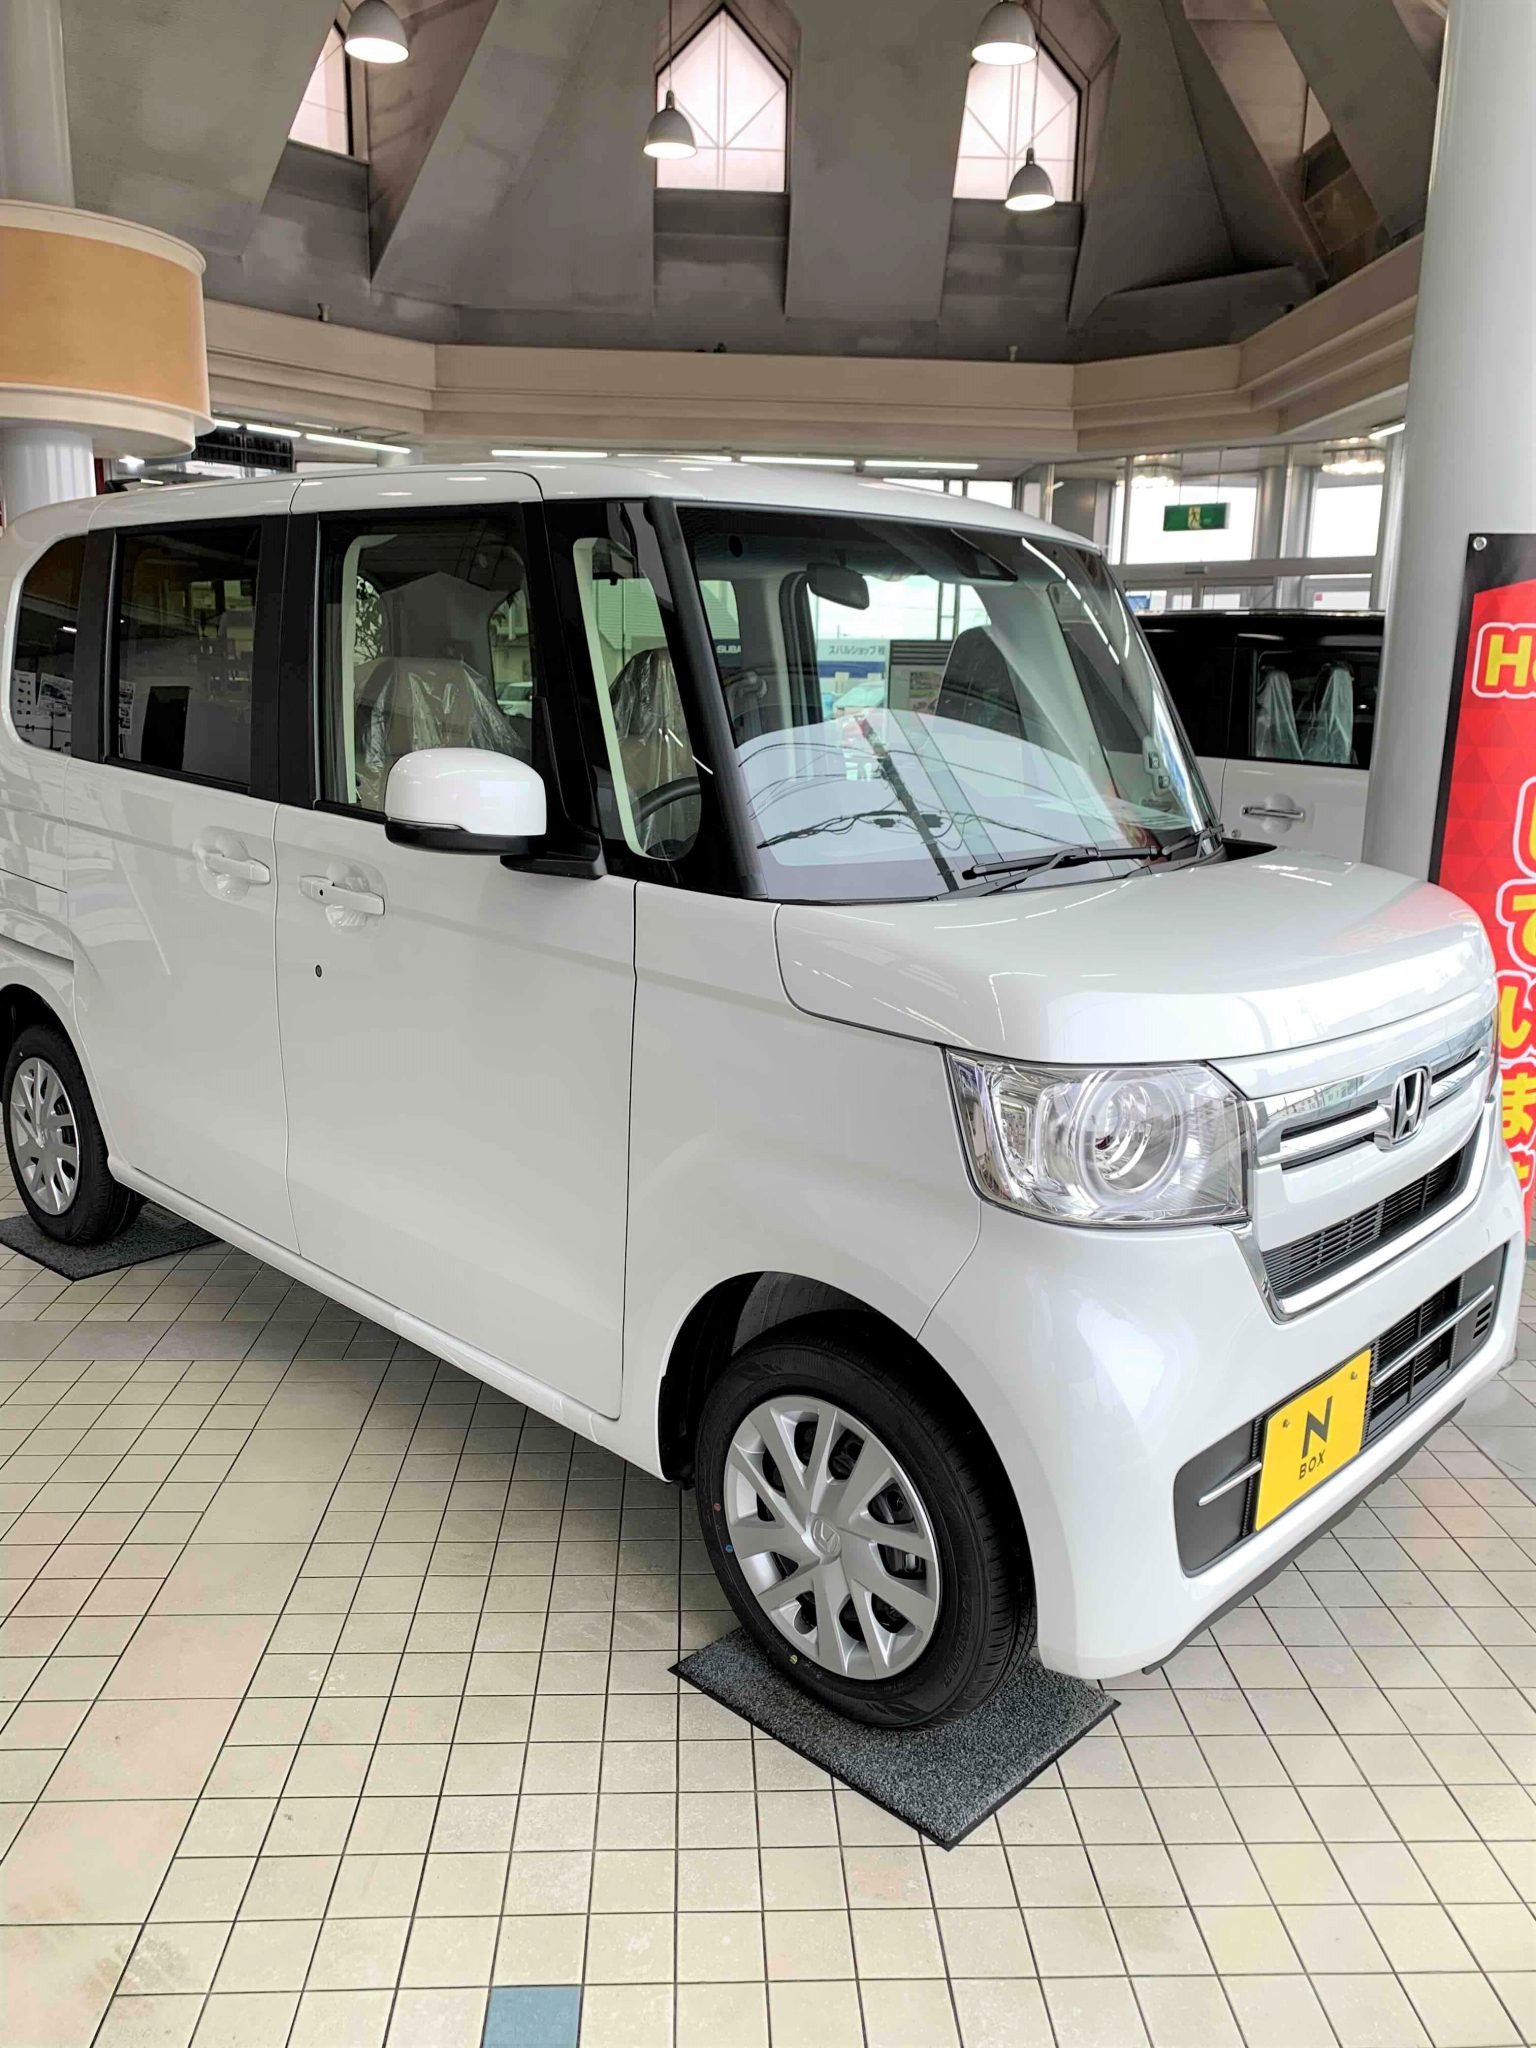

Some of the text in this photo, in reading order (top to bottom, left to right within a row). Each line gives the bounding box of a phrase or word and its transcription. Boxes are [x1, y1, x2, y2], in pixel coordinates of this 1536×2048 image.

[1485, 634, 1536, 687] H
[1302, 1395, 1333, 1459] N
[1299, 1450, 1326, 1481] BOX
